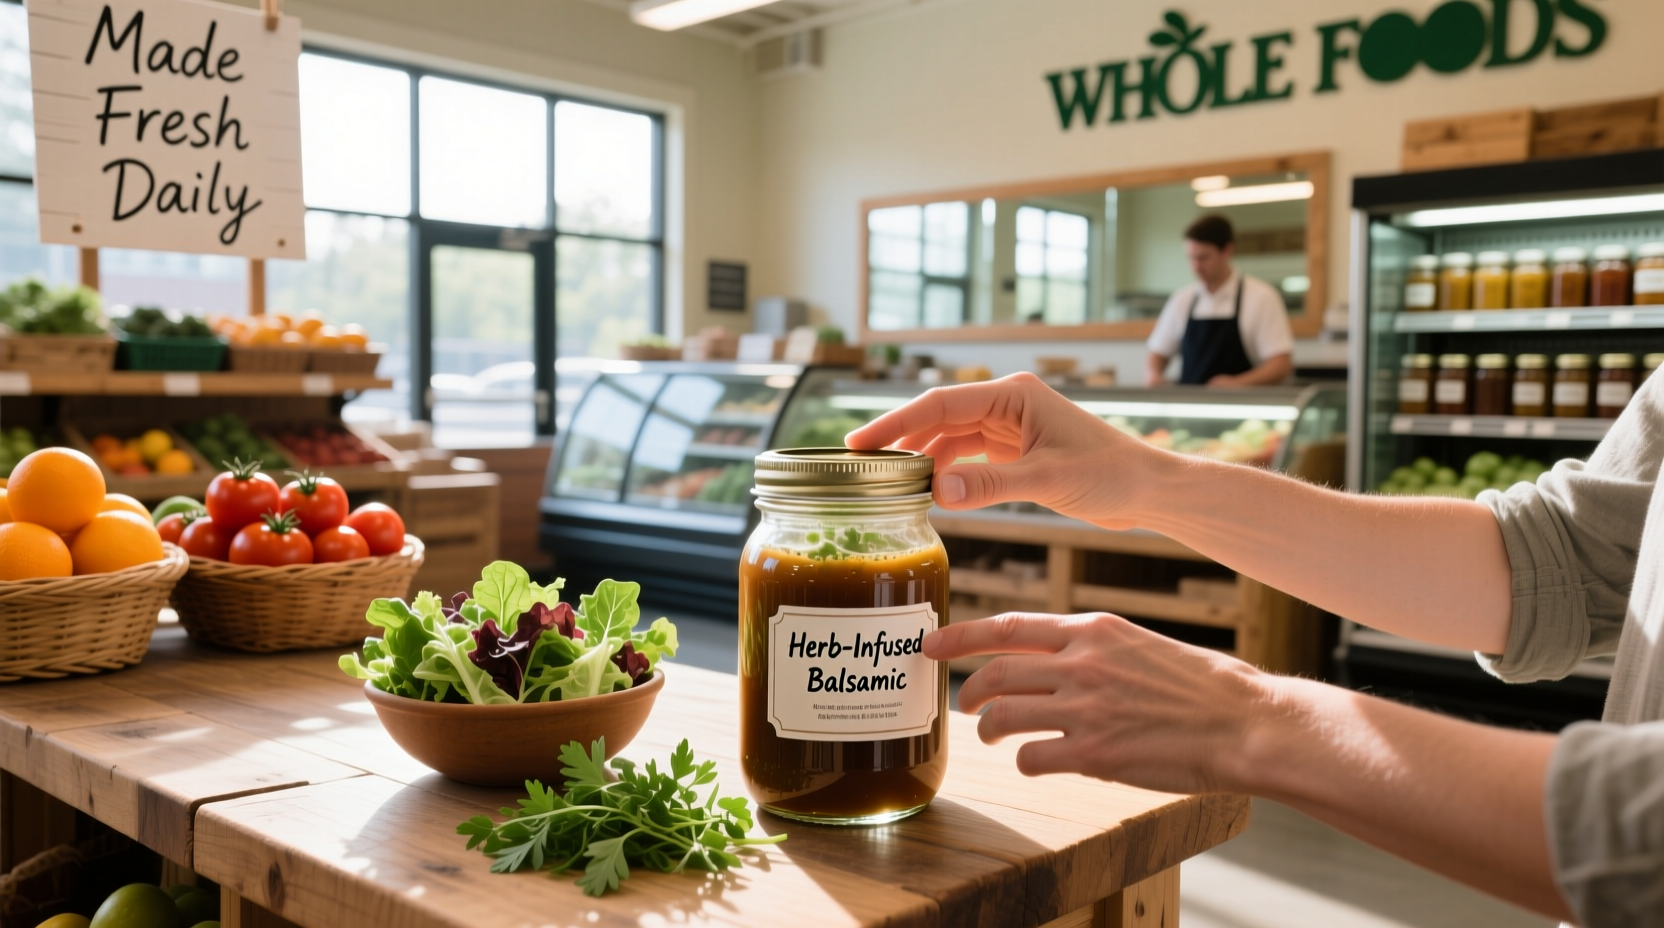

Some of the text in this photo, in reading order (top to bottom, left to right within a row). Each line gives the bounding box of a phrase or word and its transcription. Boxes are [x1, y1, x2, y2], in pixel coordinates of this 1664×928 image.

[84, 5, 244, 82] Made
[1044, 30, 1295, 131] WHOLE
[95, 85, 250, 150] Fresh
[102, 158, 263, 245] Daily
[788, 628, 924, 667] Herb-Infused
[807, 666, 907, 693] Balsamic
